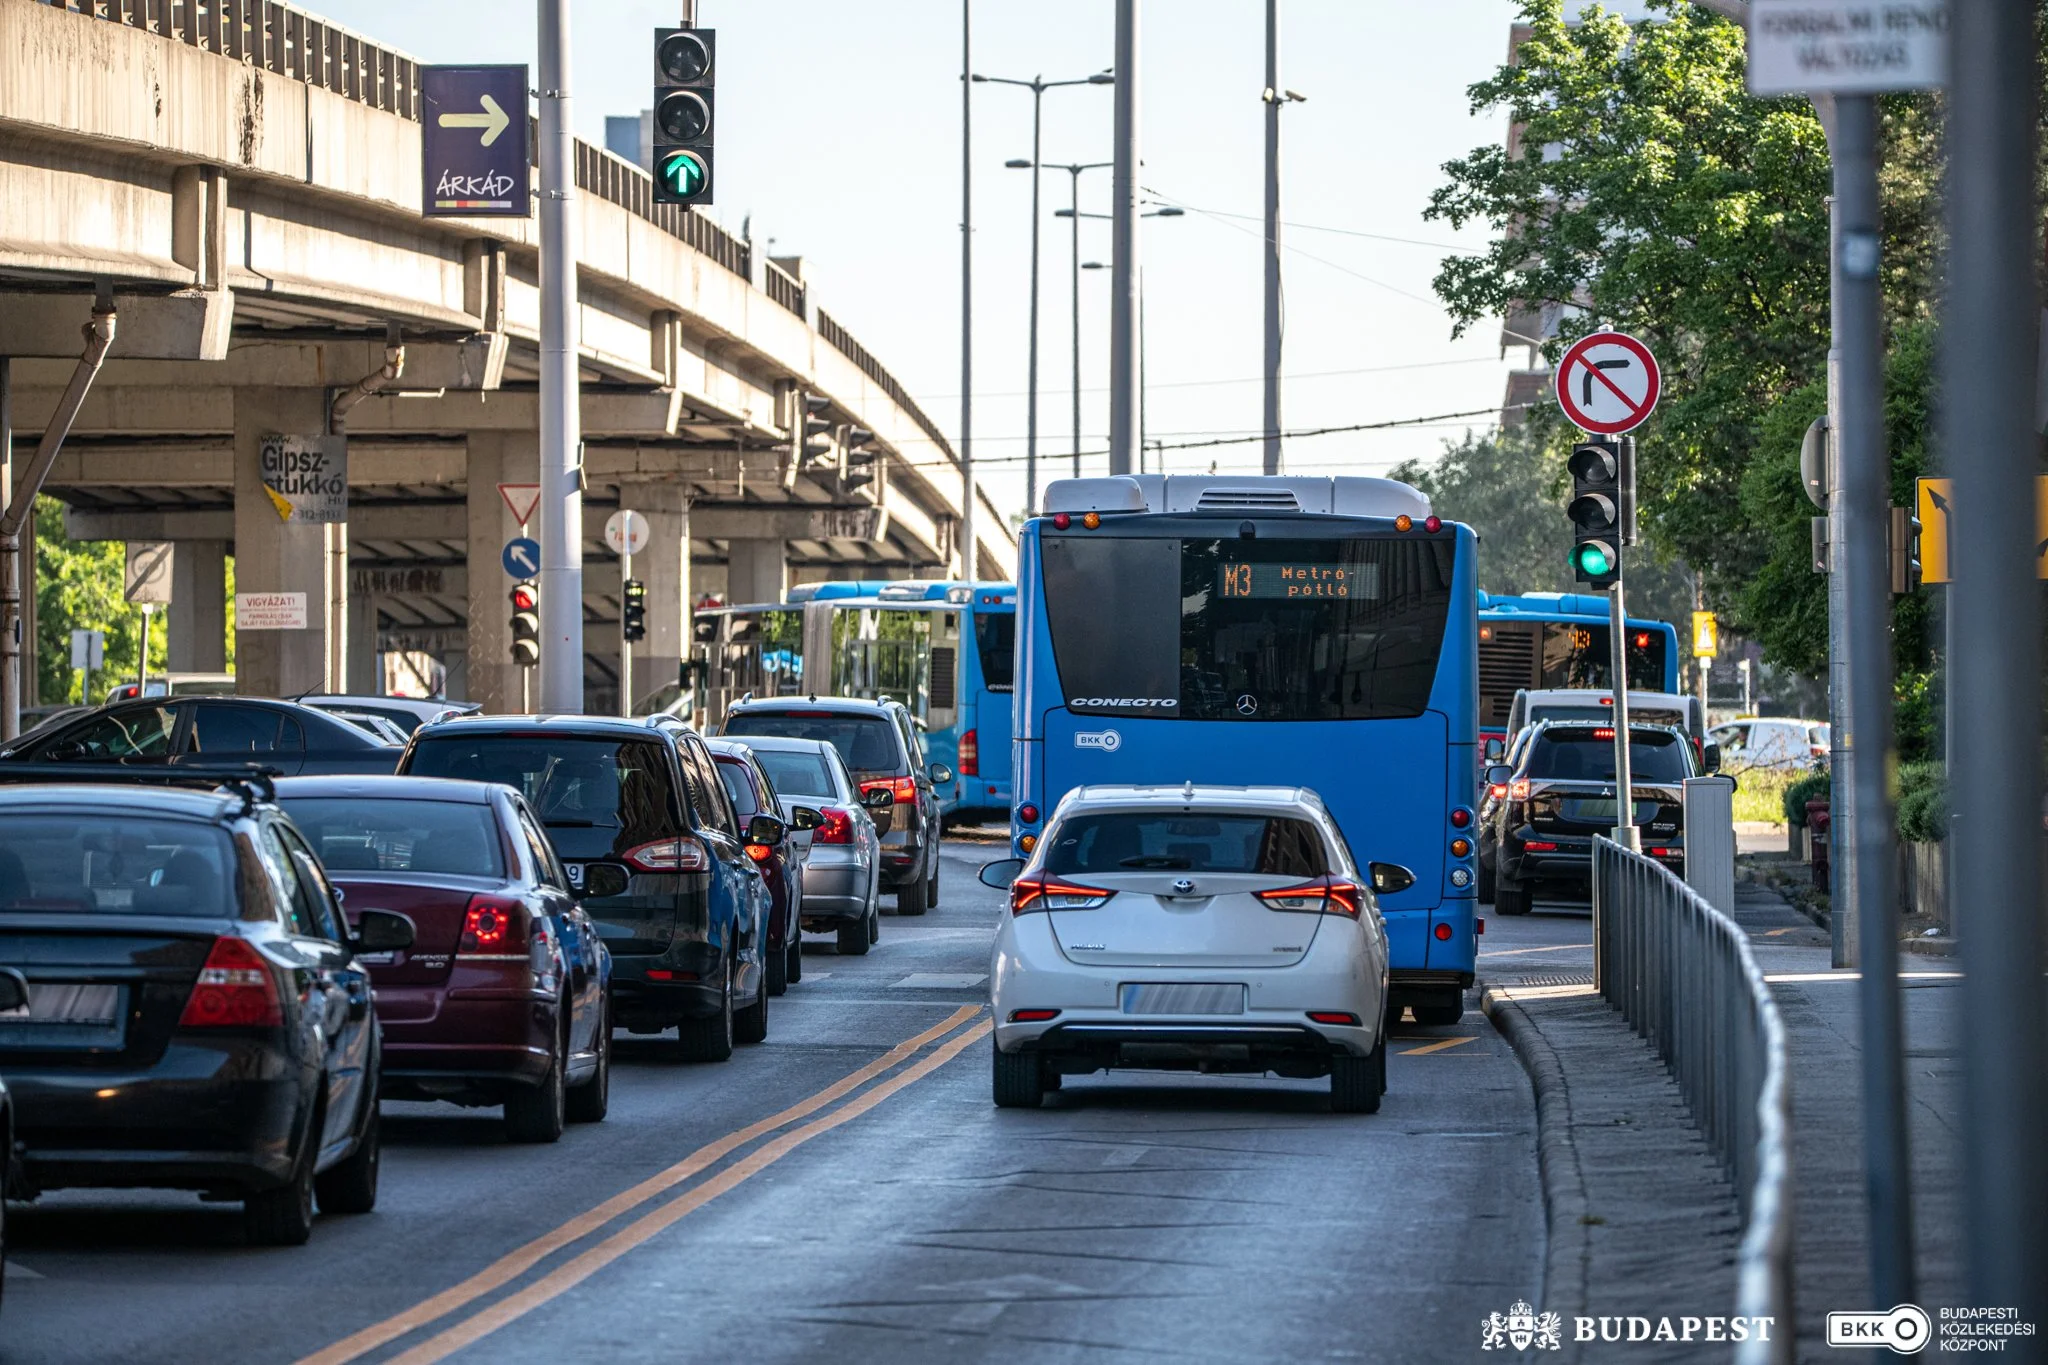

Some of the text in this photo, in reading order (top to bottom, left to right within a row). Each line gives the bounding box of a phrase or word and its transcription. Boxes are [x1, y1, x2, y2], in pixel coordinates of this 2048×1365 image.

[436, 169, 514, 197] ÁRKÁD
[262, 445, 330, 478] Gipsz-
[1224, 564, 1251, 596] M3
[1288, 583, 1347, 597] pótló
[1071, 698, 1178, 707] CONECTO
[1081, 736, 1101, 744] BKK
